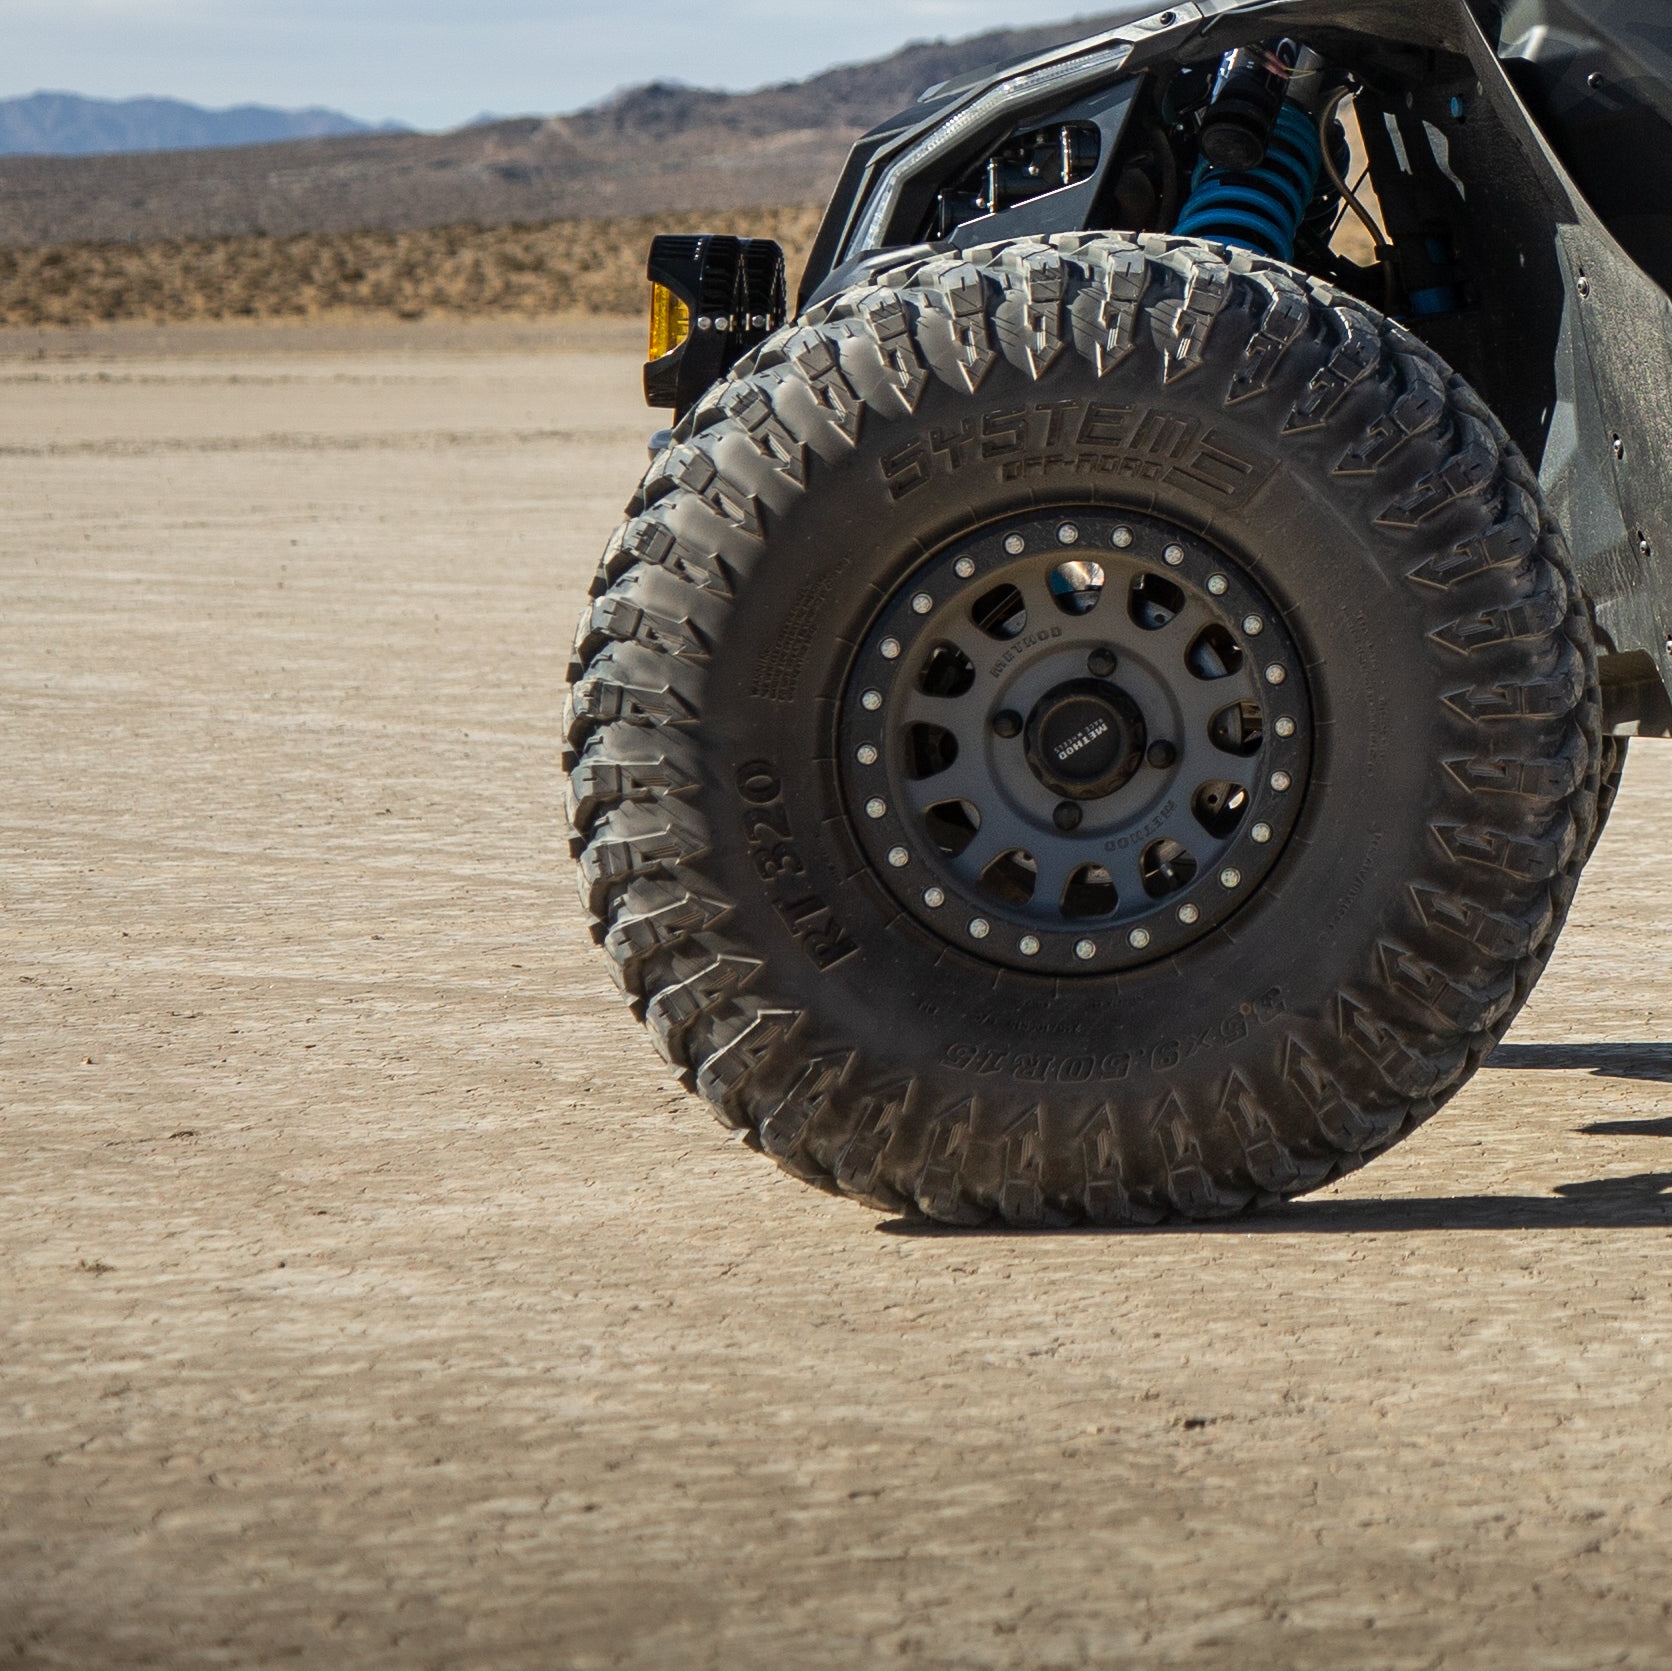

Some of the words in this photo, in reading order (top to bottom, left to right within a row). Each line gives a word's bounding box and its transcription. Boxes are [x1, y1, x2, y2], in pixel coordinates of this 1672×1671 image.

[989, 626, 1063, 678] METHOD
[1057, 722, 1109, 761] METHOD
[735, 758, 806, 882] 320
[1104, 800, 1177, 852] METHOD
[771, 894, 863, 973] RT
